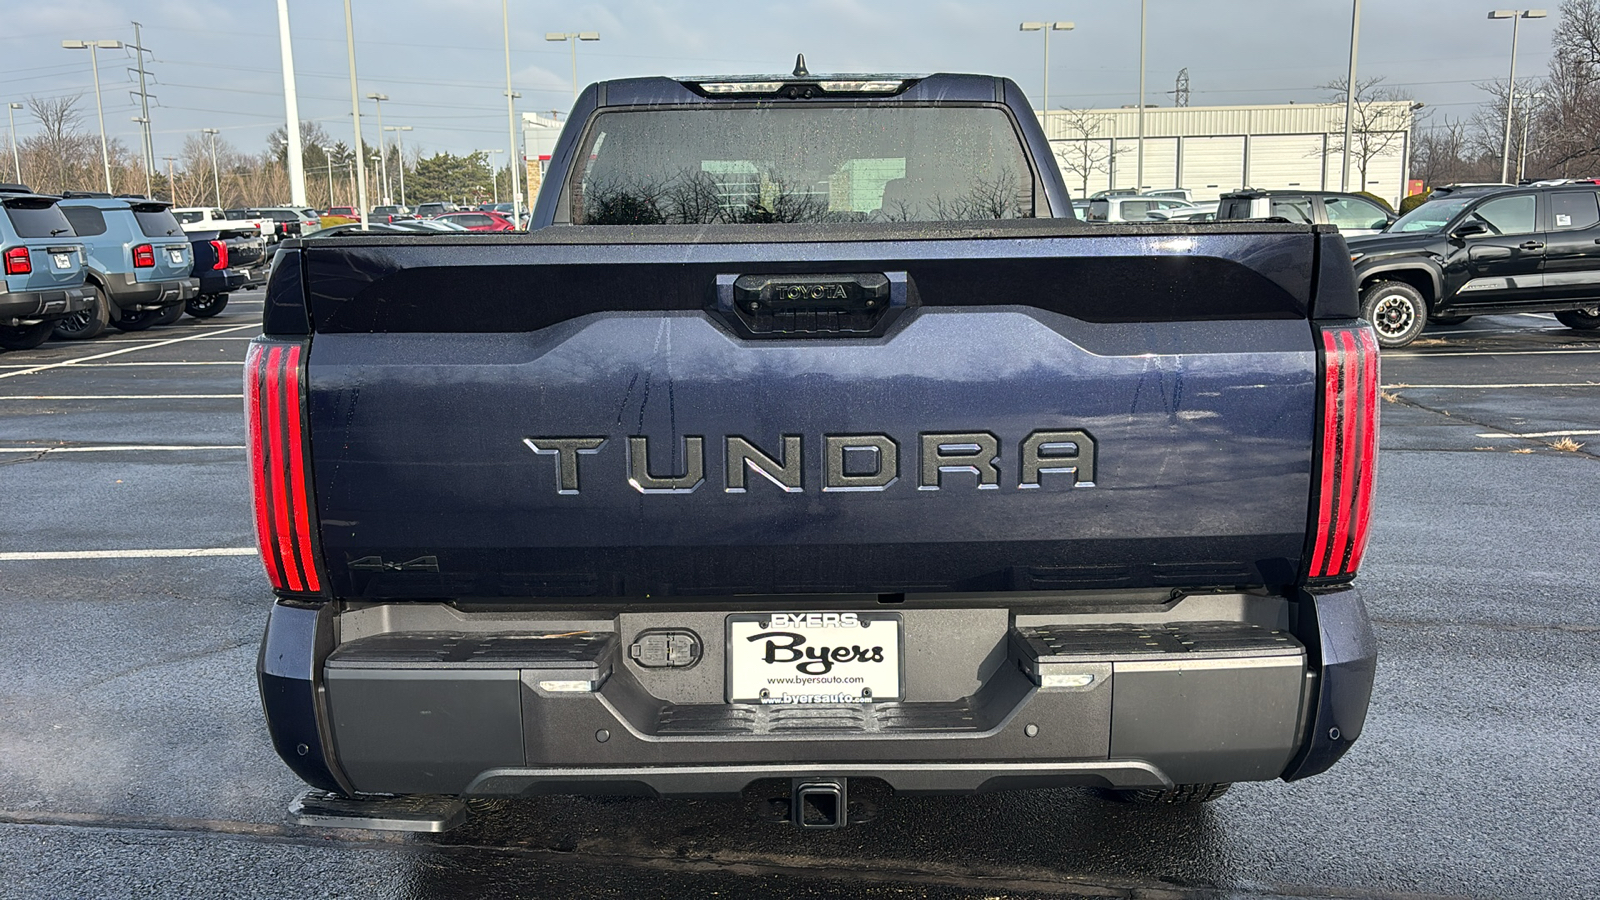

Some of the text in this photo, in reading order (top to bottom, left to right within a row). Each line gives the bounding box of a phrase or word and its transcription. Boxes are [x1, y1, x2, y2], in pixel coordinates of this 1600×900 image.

[776, 284, 847, 300] TOYOTA
[523, 428, 1097, 495] TUNDRA
[771, 613, 858, 628] BYERS
[746, 631, 884, 675] Byers
[767, 676, 864, 686] www.byersauto.com
[761, 692, 873, 704] www.byersauto.com
